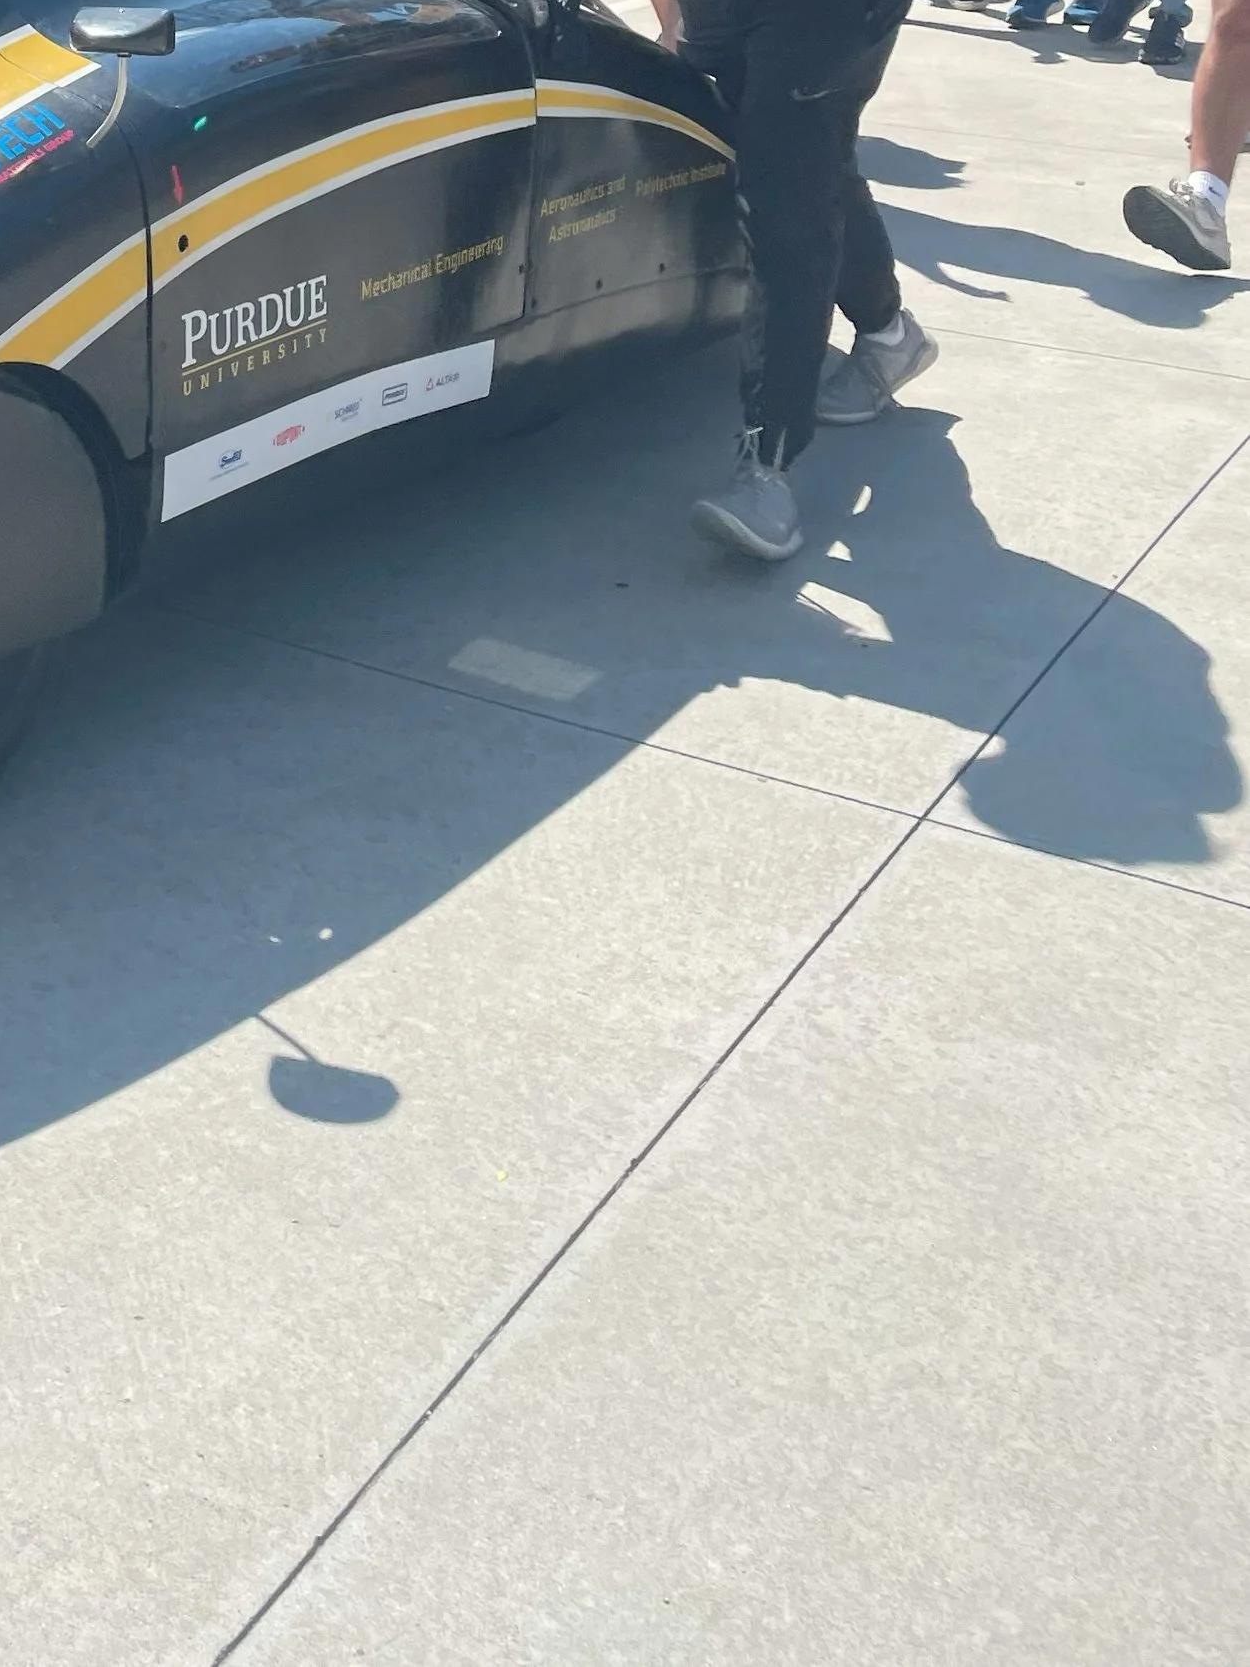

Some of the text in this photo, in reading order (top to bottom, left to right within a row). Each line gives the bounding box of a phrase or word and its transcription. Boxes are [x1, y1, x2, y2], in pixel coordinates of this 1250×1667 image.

[359, 233, 504, 302] Mechanical Engineering
[181, 275, 328, 369] PURDUE
[183, 328, 327, 396] UNIVERSITY
